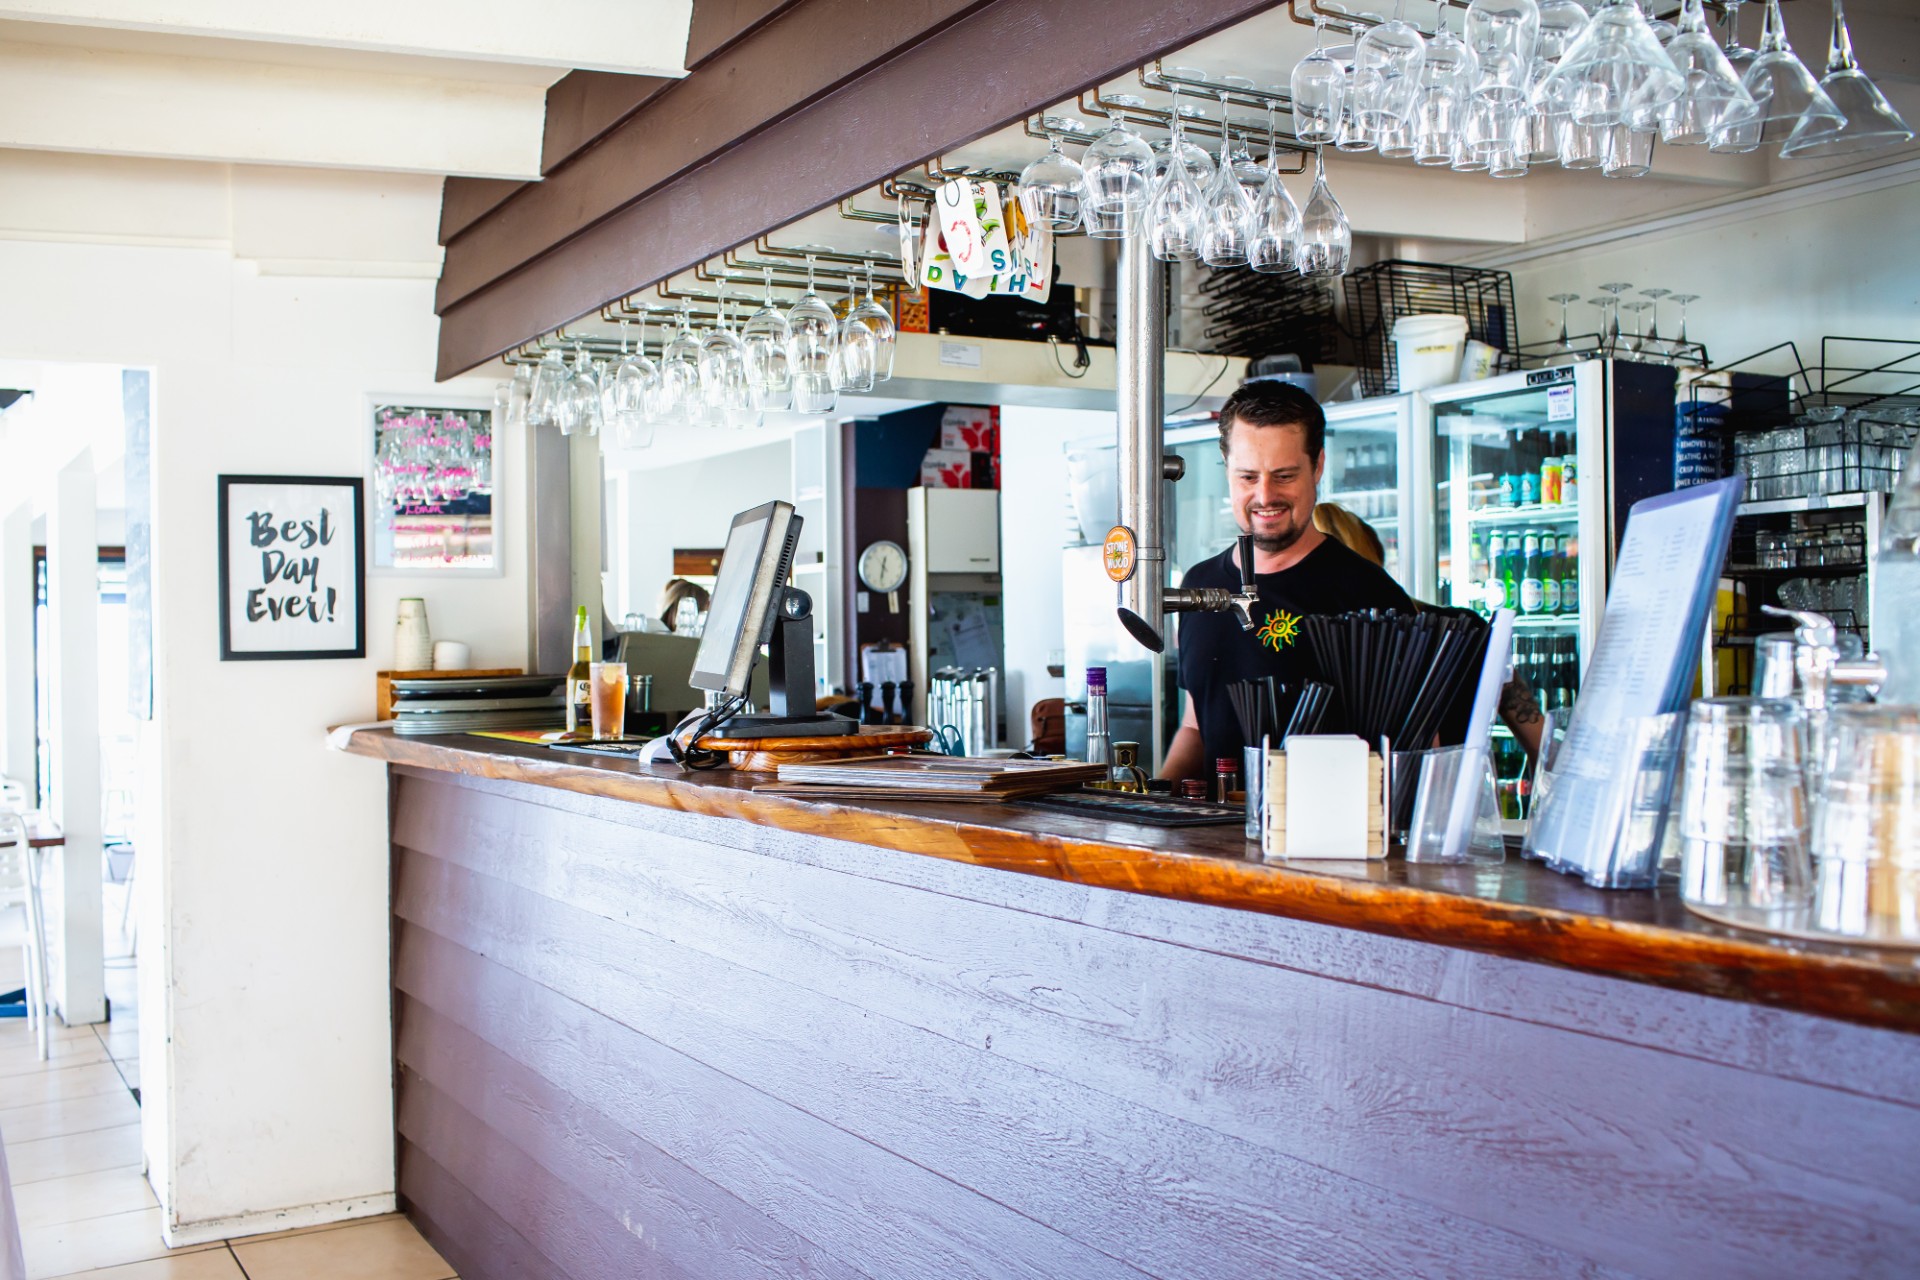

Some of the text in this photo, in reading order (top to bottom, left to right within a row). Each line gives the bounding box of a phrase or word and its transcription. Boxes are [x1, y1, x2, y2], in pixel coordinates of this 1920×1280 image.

[246, 507, 336, 550] Best
[1106, 541, 1128, 554] STONE
[1107, 557, 1128, 569] WOOD
[262, 550, 319, 593] Day
[247, 587, 336, 622] Ever!
